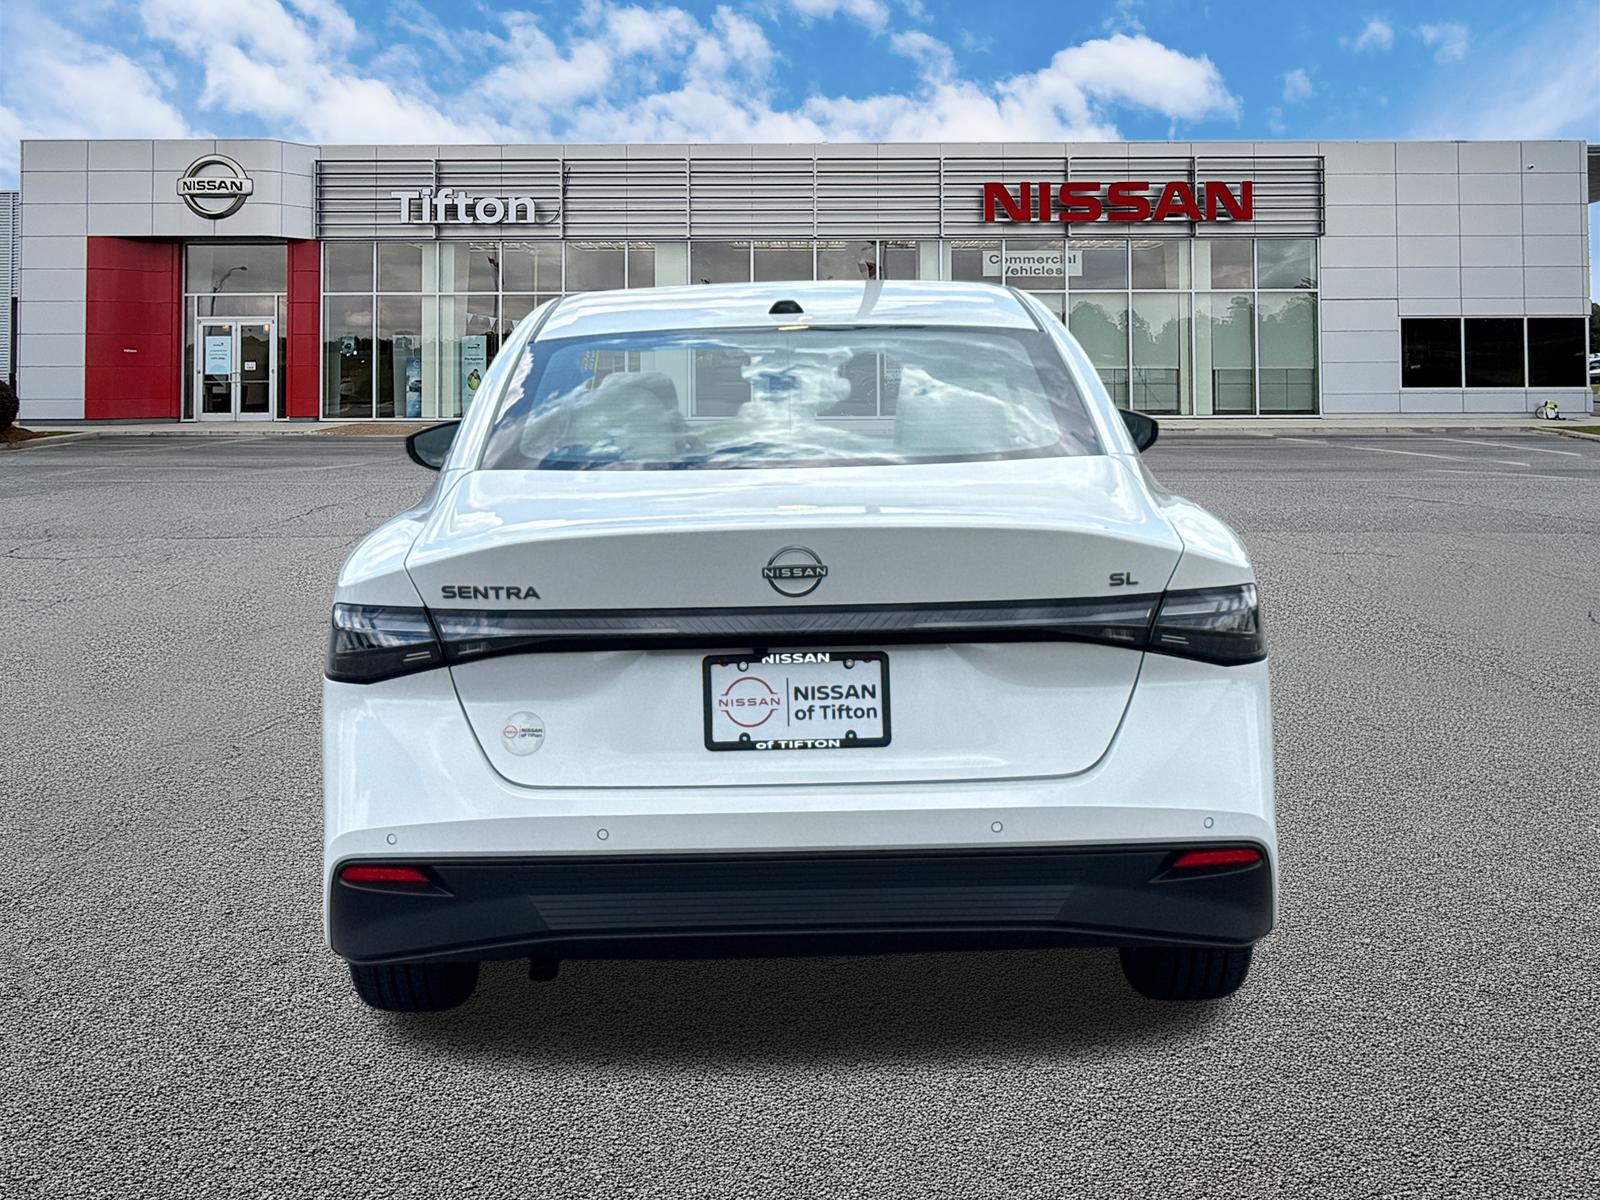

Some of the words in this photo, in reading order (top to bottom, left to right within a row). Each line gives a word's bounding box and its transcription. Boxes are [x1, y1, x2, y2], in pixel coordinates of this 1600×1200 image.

[182, 180, 243, 191] NISSAN
[391, 188, 536, 224] Tifton
[983, 180, 1253, 222] NISSAN
[763, 567, 827, 577] NISSAN
[1109, 571, 1139, 587] SL
[441, 585, 542, 600] SENTRA
[761, 653, 831, 664] NISSAN
[793, 684, 877, 701] NISSAN
[718, 697, 781, 707] NISSAN
[794, 705, 815, 720] of
[819, 703, 878, 720] Tifton
[755, 739, 775, 750] of
[777, 739, 841, 749] TIFTON
